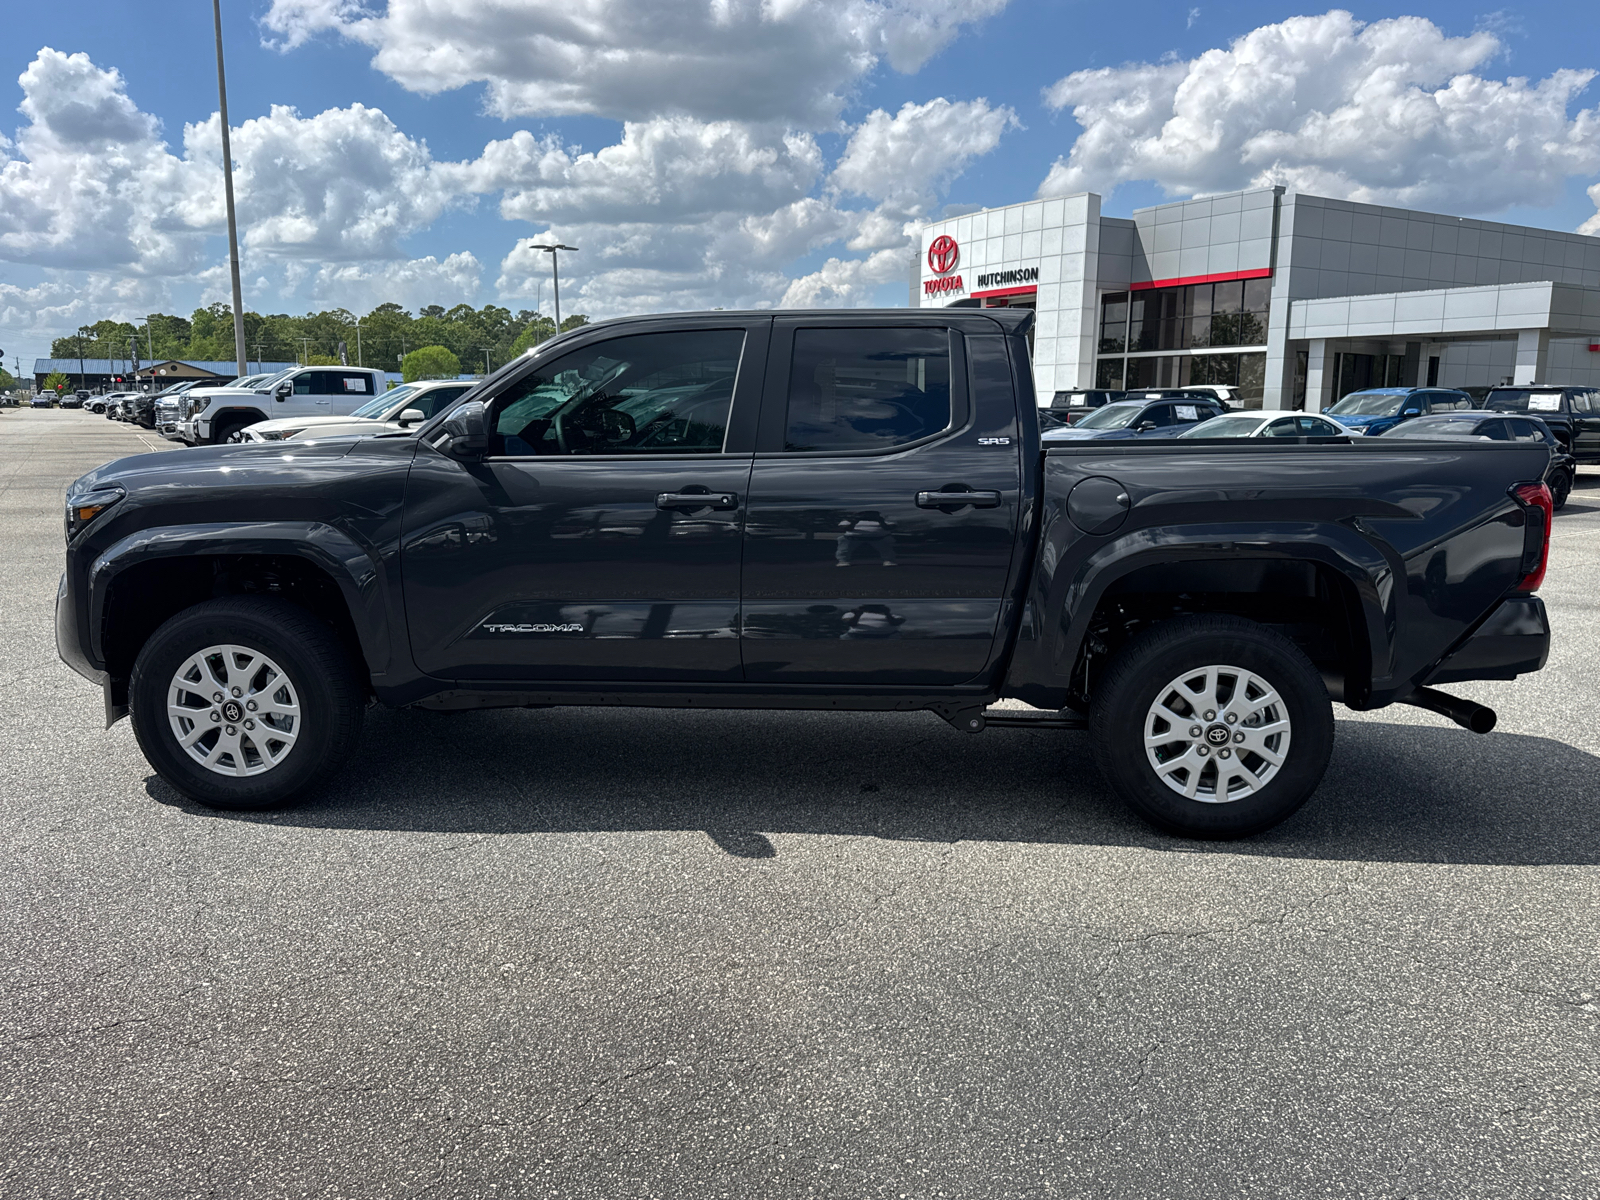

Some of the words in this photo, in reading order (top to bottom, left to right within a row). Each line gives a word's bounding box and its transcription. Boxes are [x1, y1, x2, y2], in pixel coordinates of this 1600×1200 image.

[977, 267, 1039, 287] HUTCHINSON
[923, 275, 964, 294] TOYOTA
[977, 437, 1010, 445] SR5
[483, 623, 584, 632] TACOMA
